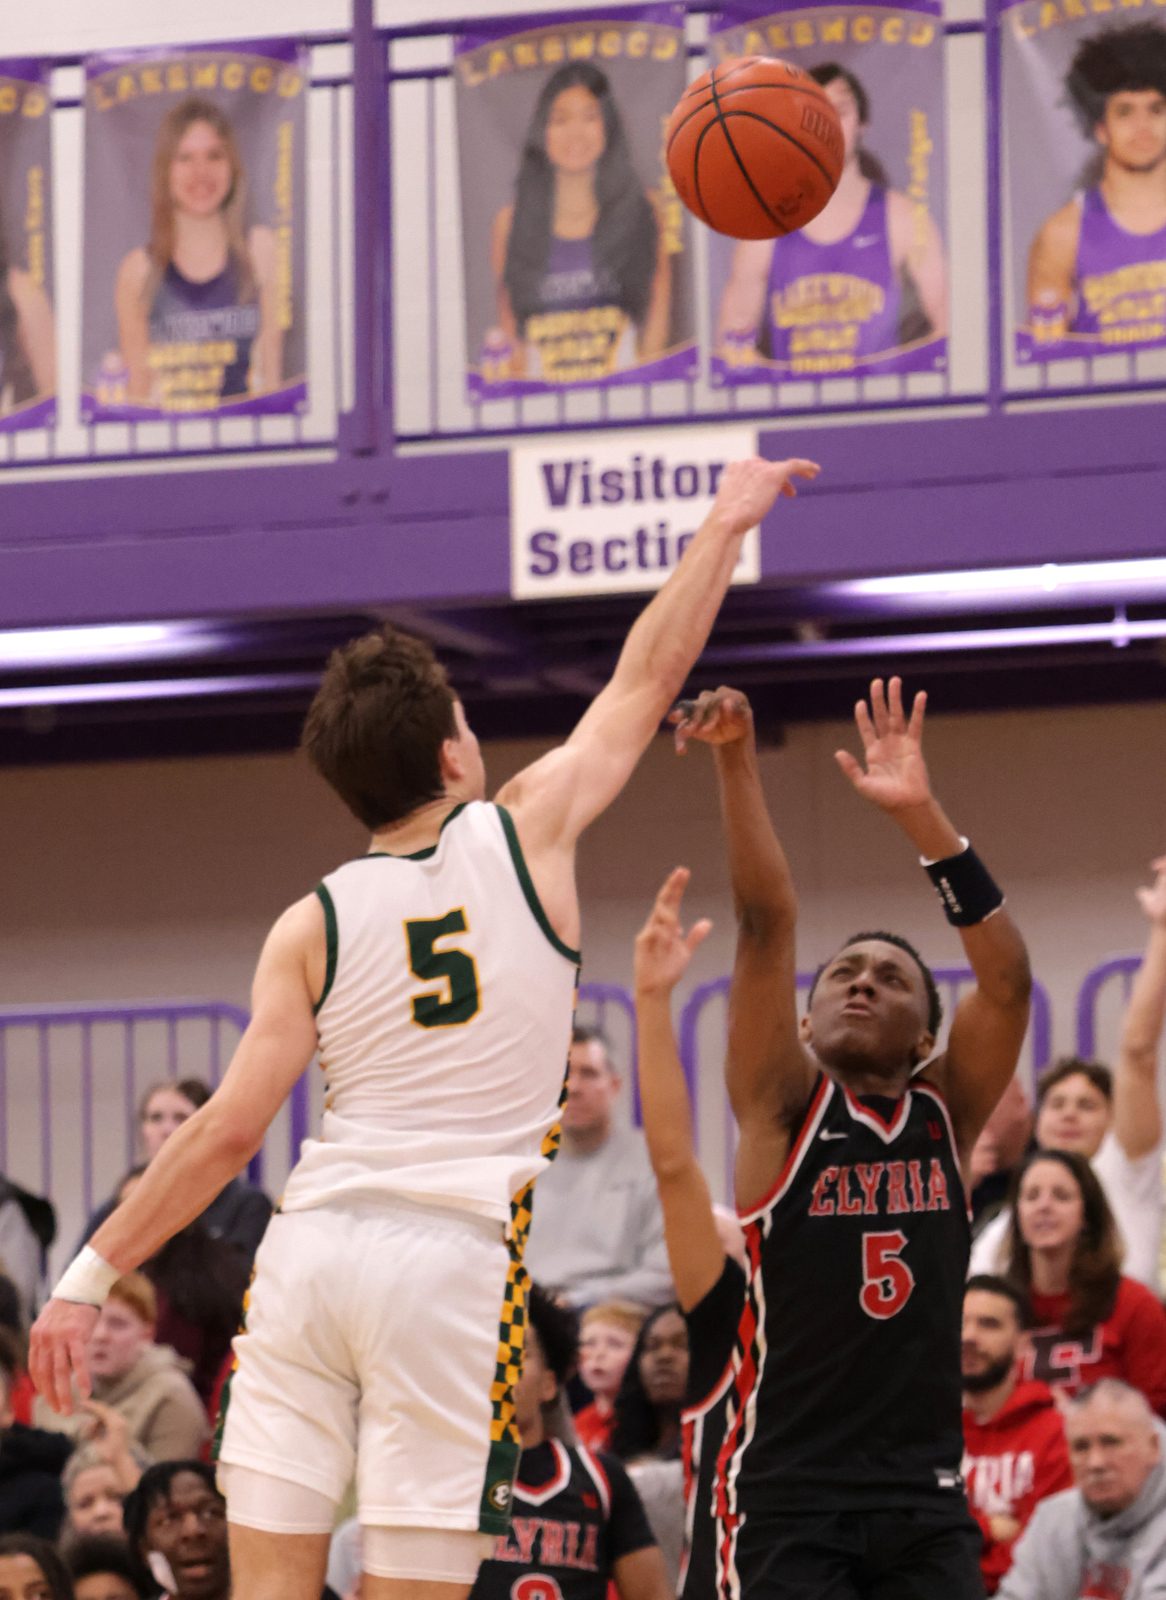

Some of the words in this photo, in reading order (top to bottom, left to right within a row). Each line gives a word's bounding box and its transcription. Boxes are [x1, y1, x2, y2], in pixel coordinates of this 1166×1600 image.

[542, 456, 724, 506] Visitor
[403, 905, 483, 1031] 5
[808, 1158, 950, 1216] ELYRIA
[859, 1229, 915, 1320] 5
